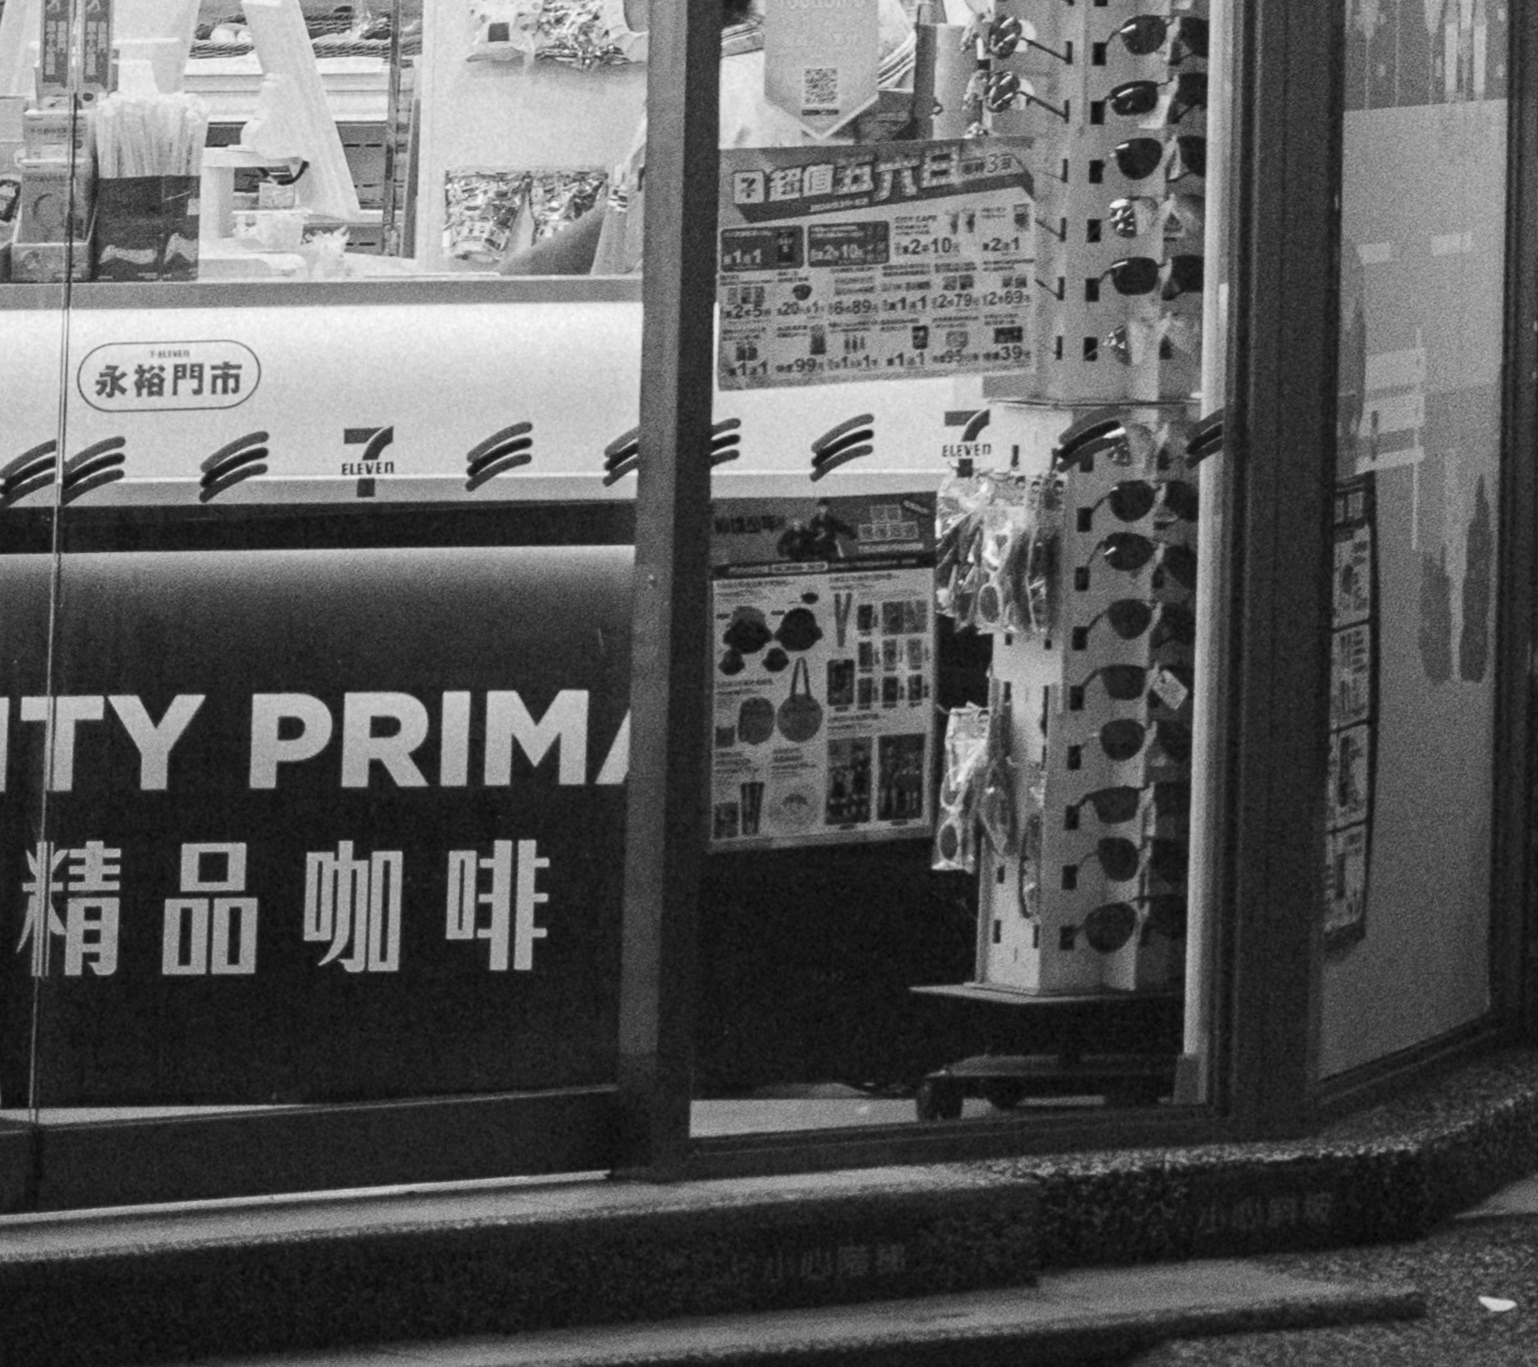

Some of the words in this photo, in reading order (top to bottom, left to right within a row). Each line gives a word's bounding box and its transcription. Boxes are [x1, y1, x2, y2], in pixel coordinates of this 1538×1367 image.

[95, 361, 243, 399] 永裕門市
[16, 839, 550, 977] 精品咖啡
